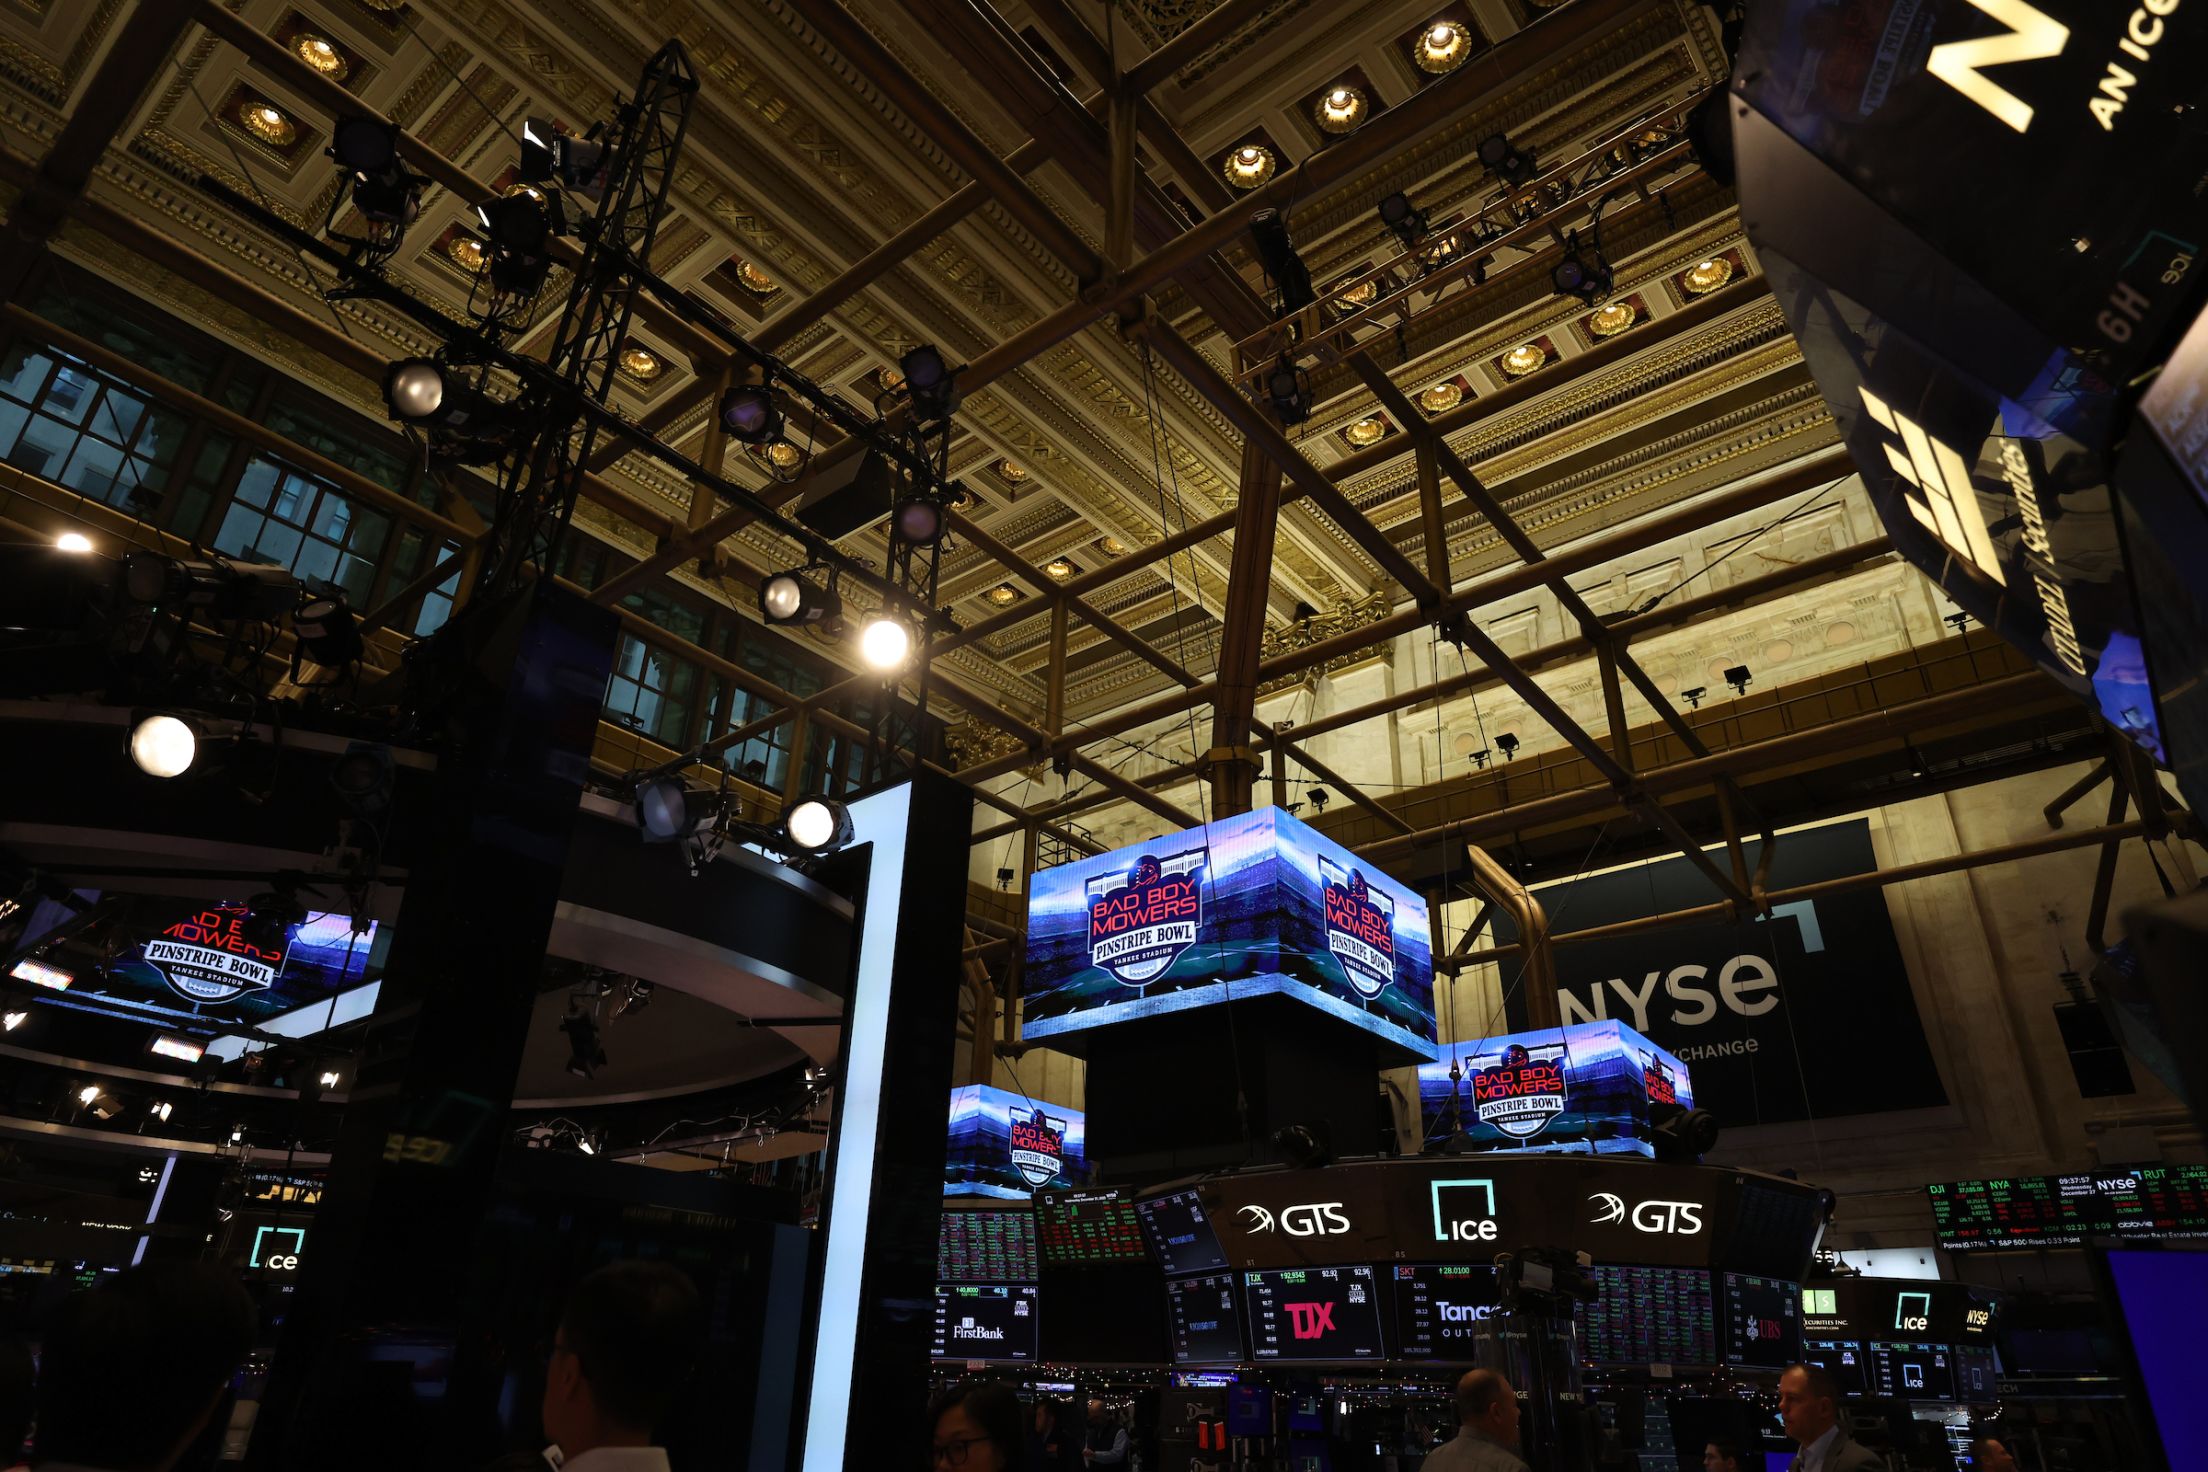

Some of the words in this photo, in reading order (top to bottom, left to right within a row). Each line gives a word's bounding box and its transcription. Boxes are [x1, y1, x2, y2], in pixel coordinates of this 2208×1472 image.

[2087, 61, 2138, 132] AN
[2032, 574, 2087, 677] CITADEL
[1093, 894, 1140, 918] BAD
[1147, 879, 1196, 905] BOY
[1093, 896, 1197, 936] MOWERS
[1326, 887, 1357, 917] BAD
[1361, 907, 1390, 933] BOY
[1327, 905, 1393, 953] MOWERS
[1096, 930, 1153, 960] PINSTRIPE
[1157, 924, 1193, 942] BOWL
[150, 943, 226, 969] PINSTRIPE
[229, 958, 270, 984] BOWL
[1114, 955, 1140, 965] YANKEE
[1142, 947, 1173, 959] STADIUM
[1331, 933, 1368, 961] PINSTRIPE
[1371, 949, 1392, 977] BOWL
[170, 965, 205, 978] YANKEE
[206, 973, 245, 987] STADIUM
[1475, 1071, 1513, 1087] BAD
[1520, 1065, 1560, 1081] BOY
[1476, 1077, 1563, 1100] MOWERS
[1482, 1098, 1529, 1117] PINSTRIPE
[1532, 1097, 1562, 1110] BOWL
[1520, 1112, 1546, 1121] STADIUM
[1013, 1125, 1037, 1139] BAD
[1014, 1151, 1041, 1163] PINSTRIPE
[1989, 1180, 2011, 1190] NYA
[2144, 1169, 2166, 1180] RUT
[1929, 1185, 1946, 1195] DJI
[1280, 1202, 1351, 1236] GTS
[1632, 1200, 1703, 1235] GTS
[1250, 1274, 1262, 1282] TJX
[1400, 1268, 1416, 1276] SKT
[1284, 1302, 1337, 1339] TJX
[1760, 1319, 1782, 1340] UBS
[954, 1325, 1004, 1339] FirstBank
